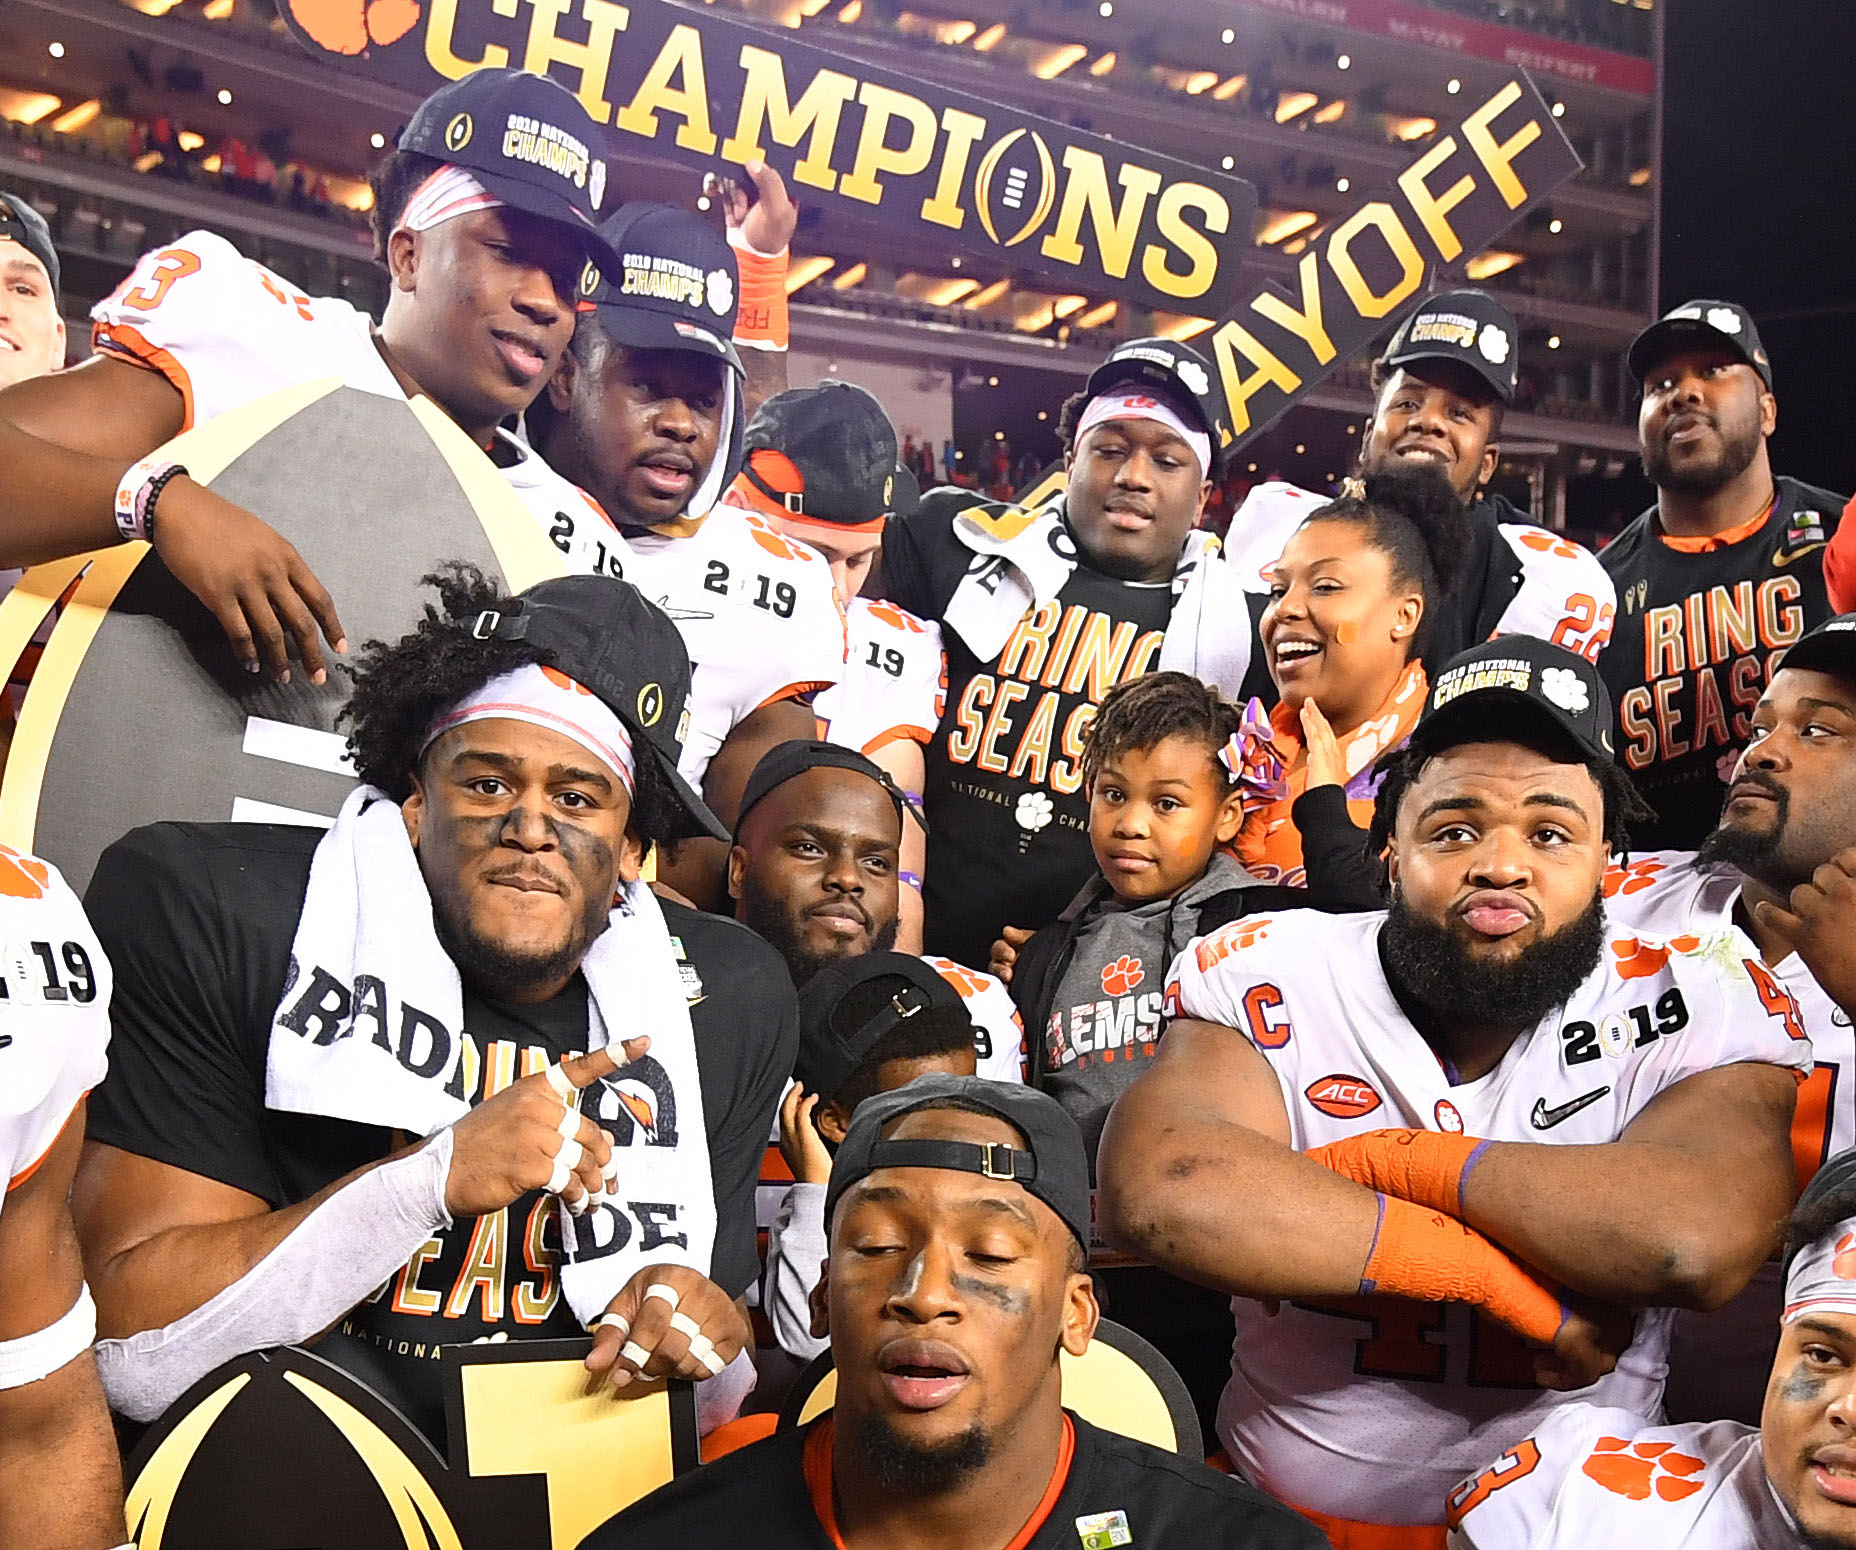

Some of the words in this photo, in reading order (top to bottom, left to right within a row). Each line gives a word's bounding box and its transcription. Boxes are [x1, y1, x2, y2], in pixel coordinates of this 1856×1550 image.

[1211, 80, 1543, 442] AYOFF
[1645, 574, 1804, 683] RING
[1620, 649, 1789, 771] SEAS
[1242, 983, 1291, 1049] C
[1325, 1084, 1373, 1104] ACC
